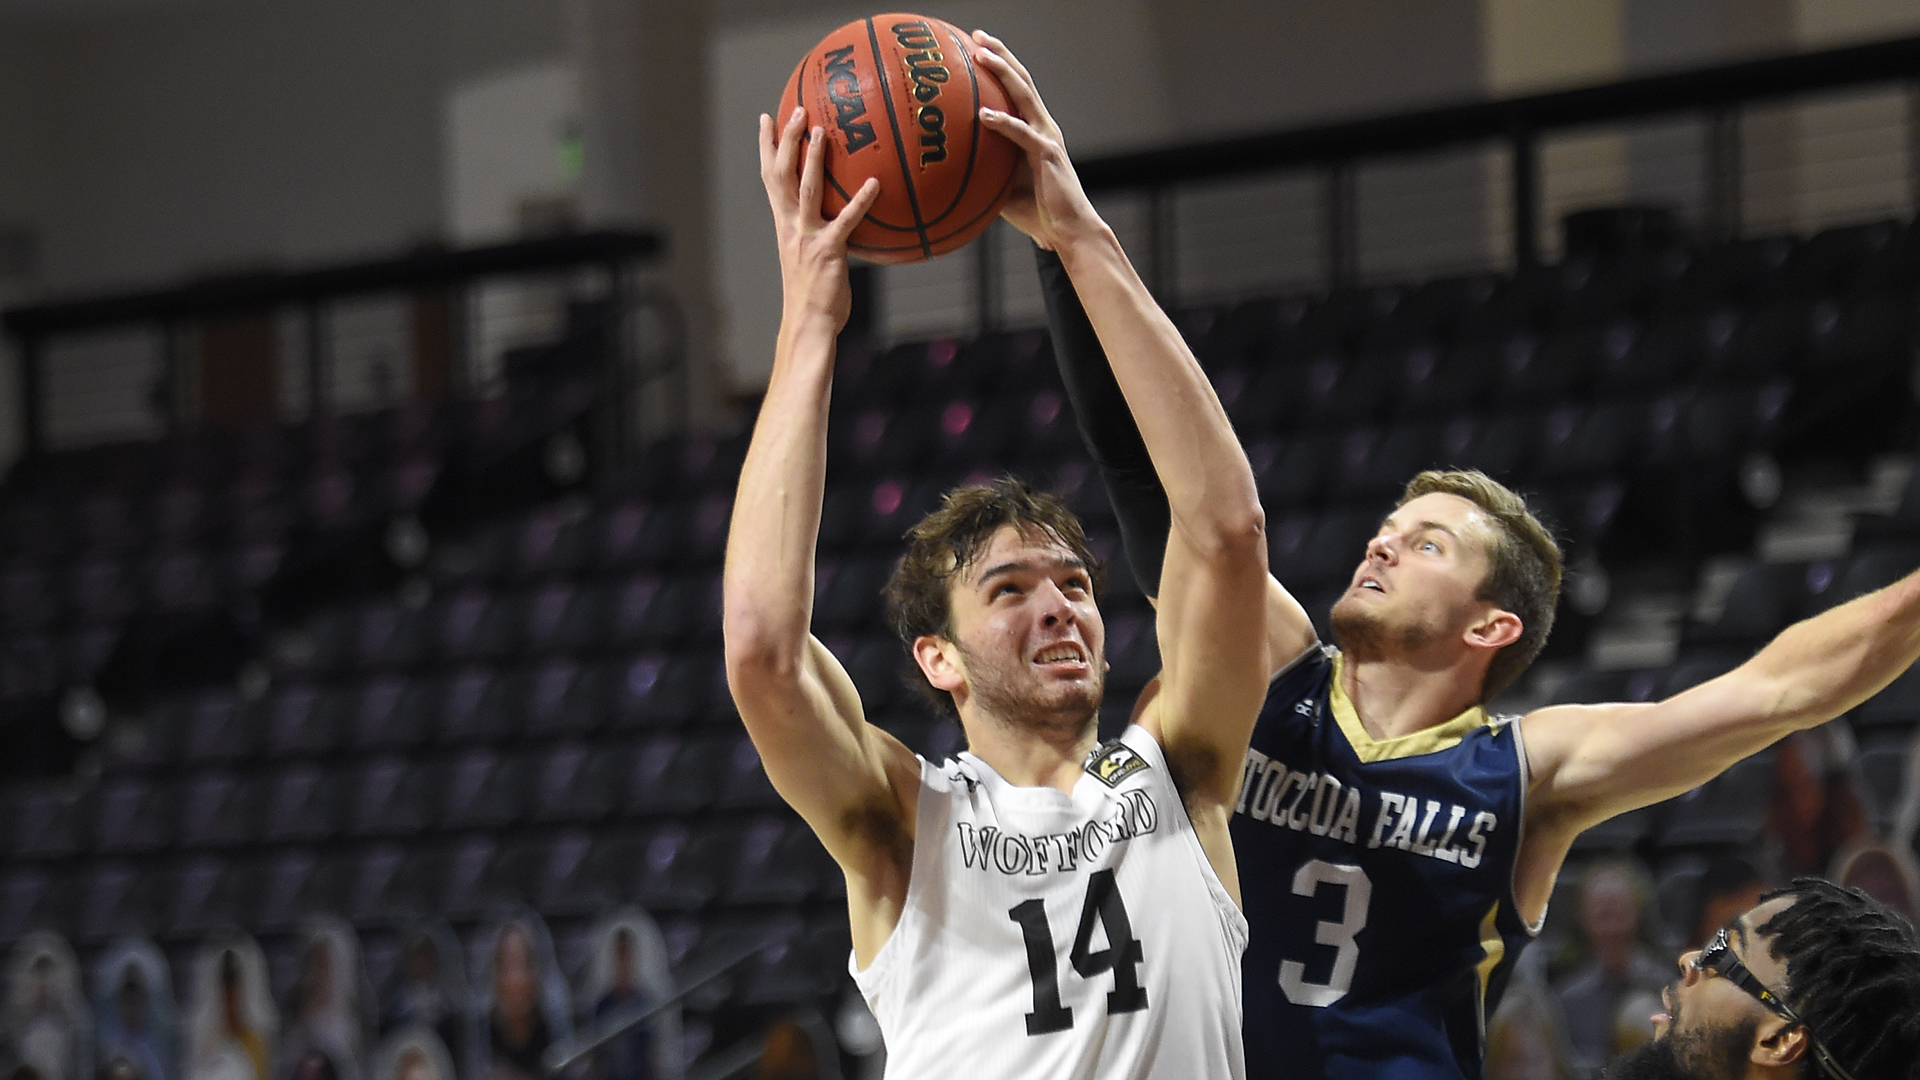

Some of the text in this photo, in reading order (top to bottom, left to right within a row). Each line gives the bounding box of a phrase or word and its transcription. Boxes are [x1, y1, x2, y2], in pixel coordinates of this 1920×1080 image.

[824, 44, 878, 156] NCAA
[890, 20, 950, 168] Wilson
[957, 788, 1158, 876] WOFFORD
[1235, 746, 1498, 870] TOCCOA FALLS
[1007, 867, 1150, 1037] 14
[1278, 859, 1373, 1008] 3
